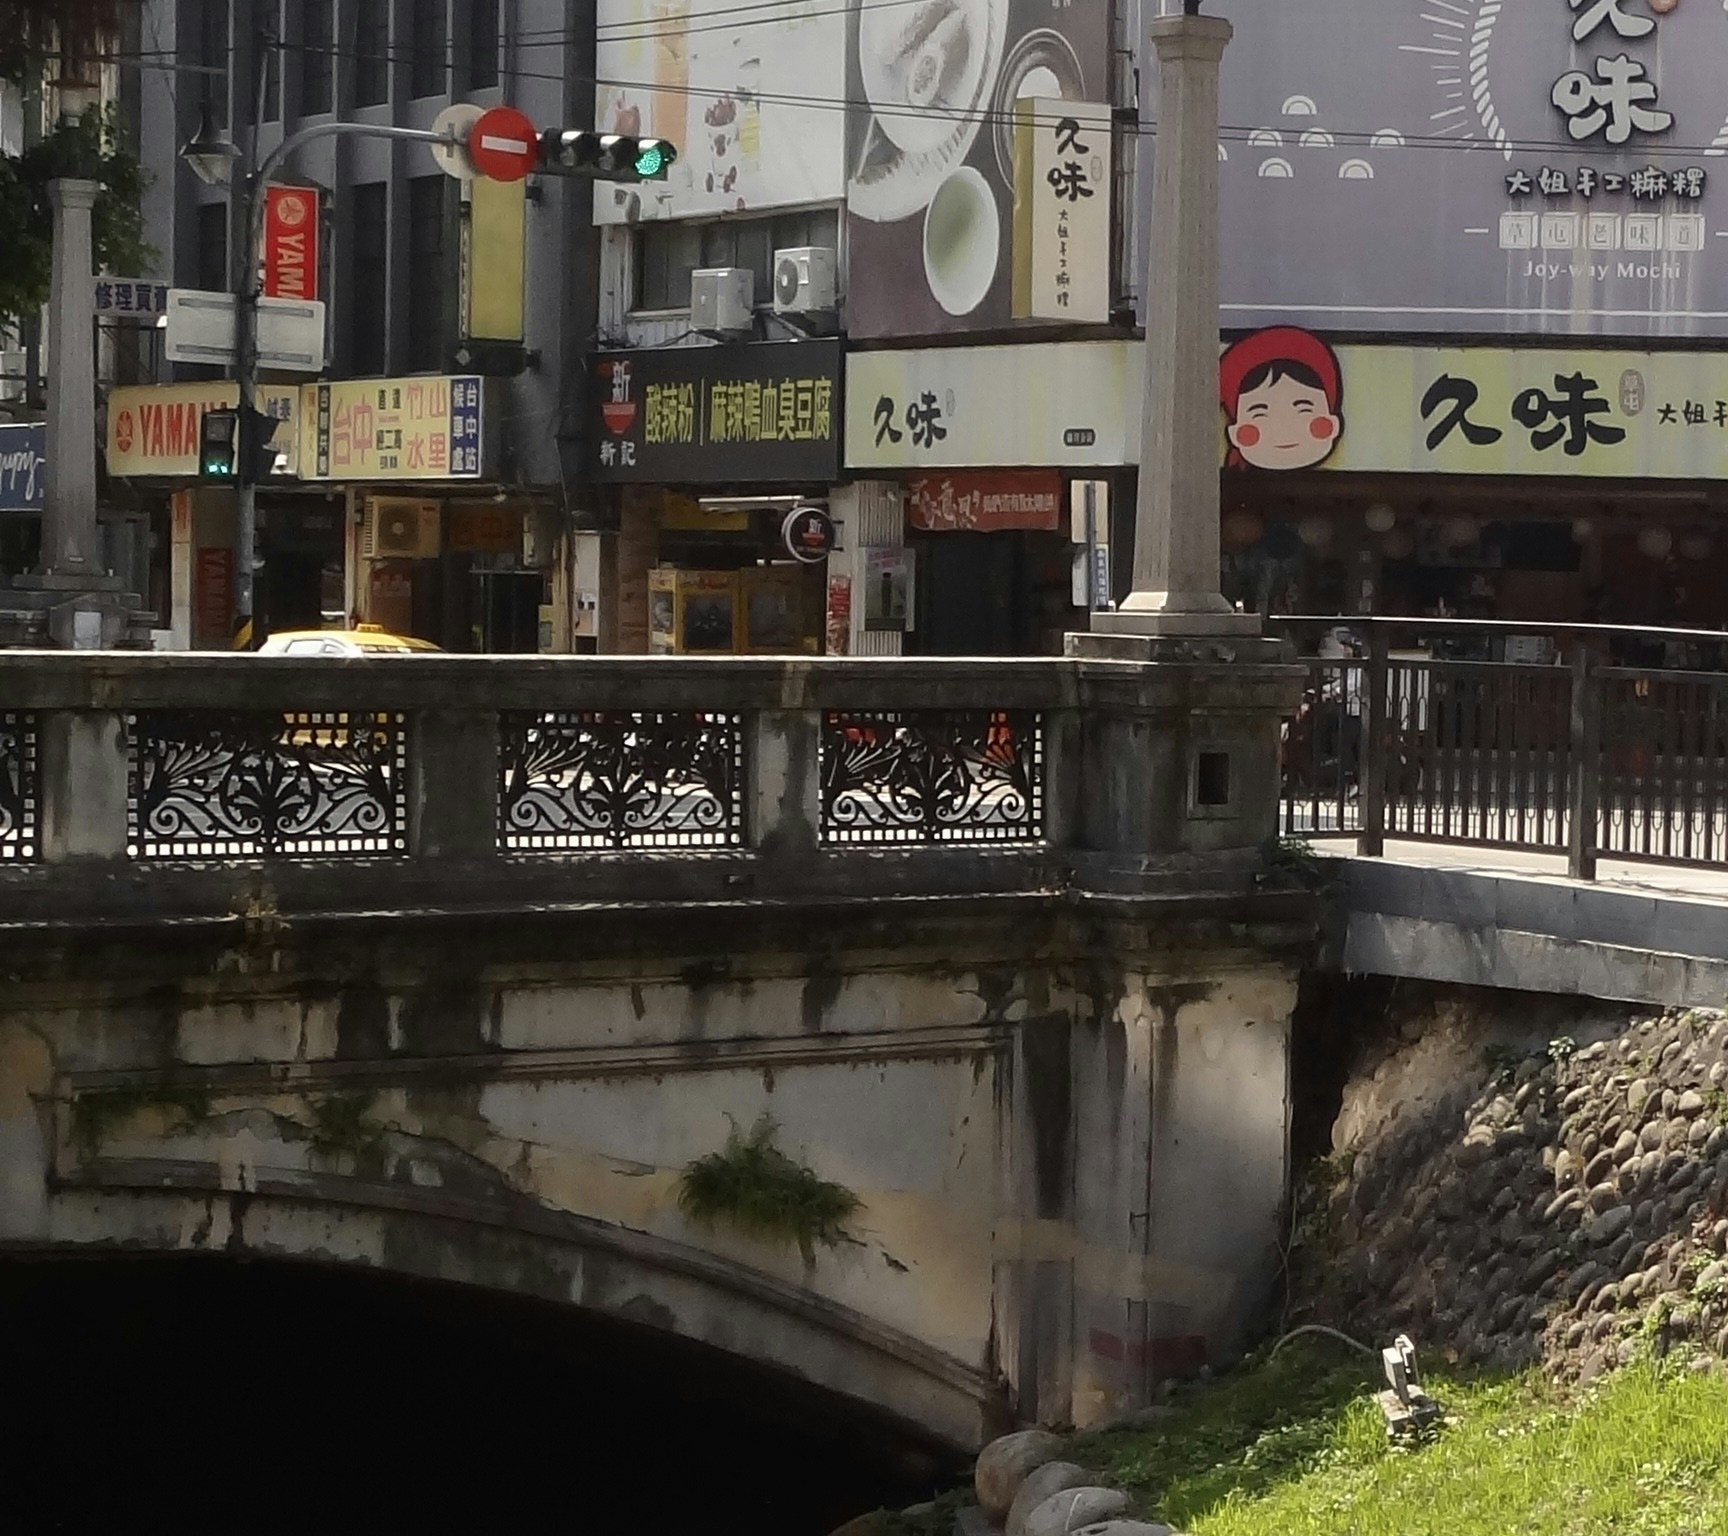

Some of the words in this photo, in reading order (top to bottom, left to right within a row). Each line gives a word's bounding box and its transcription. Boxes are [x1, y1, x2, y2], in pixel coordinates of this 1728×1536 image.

[1047, 118, 1094, 202] 久味
[277, 232, 305, 300] YAM
[1617, 262, 1682, 279] Mochi
[139, 401, 228, 457] YAMA
[874, 389, 947, 448] 久味
[1420, 370, 1626, 457] 久味
[600, 440, 637, 467] 新記
